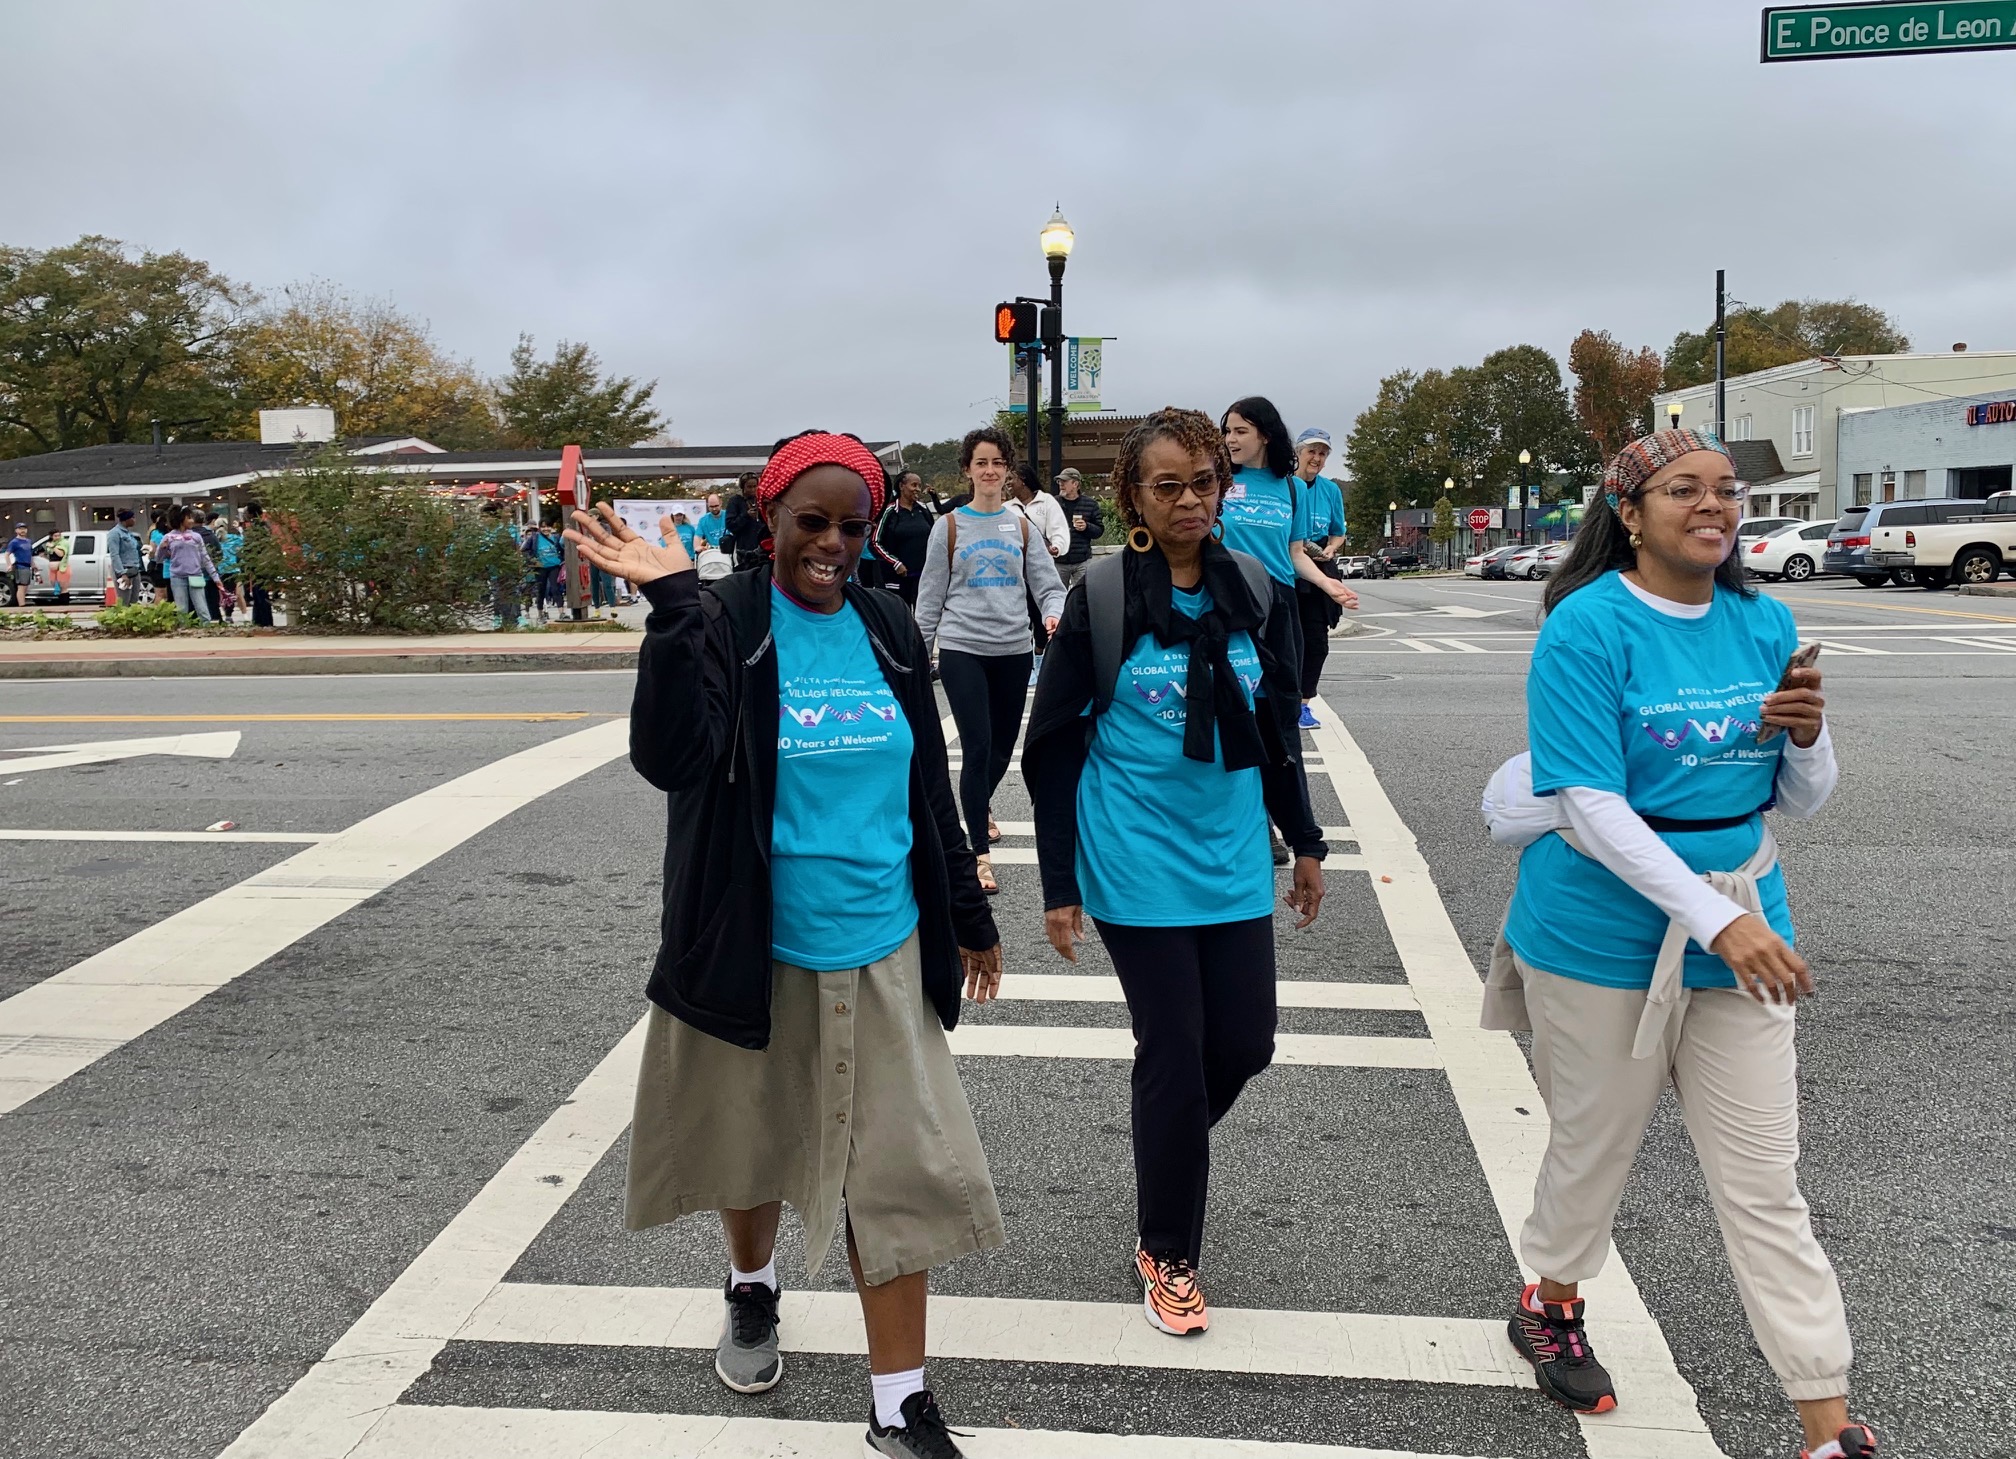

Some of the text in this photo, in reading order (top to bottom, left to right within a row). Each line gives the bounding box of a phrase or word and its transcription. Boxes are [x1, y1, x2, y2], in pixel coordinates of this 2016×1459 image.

[1777, 18, 1802, 48] E.
[1811, 17, 1889, 47] Ponce
[1899, 17, 1929, 42] de
[1937, 9, 2001, 40] Leon
[1070, 344, 1078, 387] WELCOME
[1470, 515, 1489, 524] STOP
[1131, 665, 1169, 675] GLOBAL
[1170, 664, 1189, 674] VILL
[788, 688, 829, 699] VILLAGE
[1639, 702, 1687, 716] GLOBAL
[1687, 700, 1725, 711] VILLAGE
[794, 739, 826, 749] Years
[828, 736, 841, 747] of
[1722, 750, 1736, 759] of
